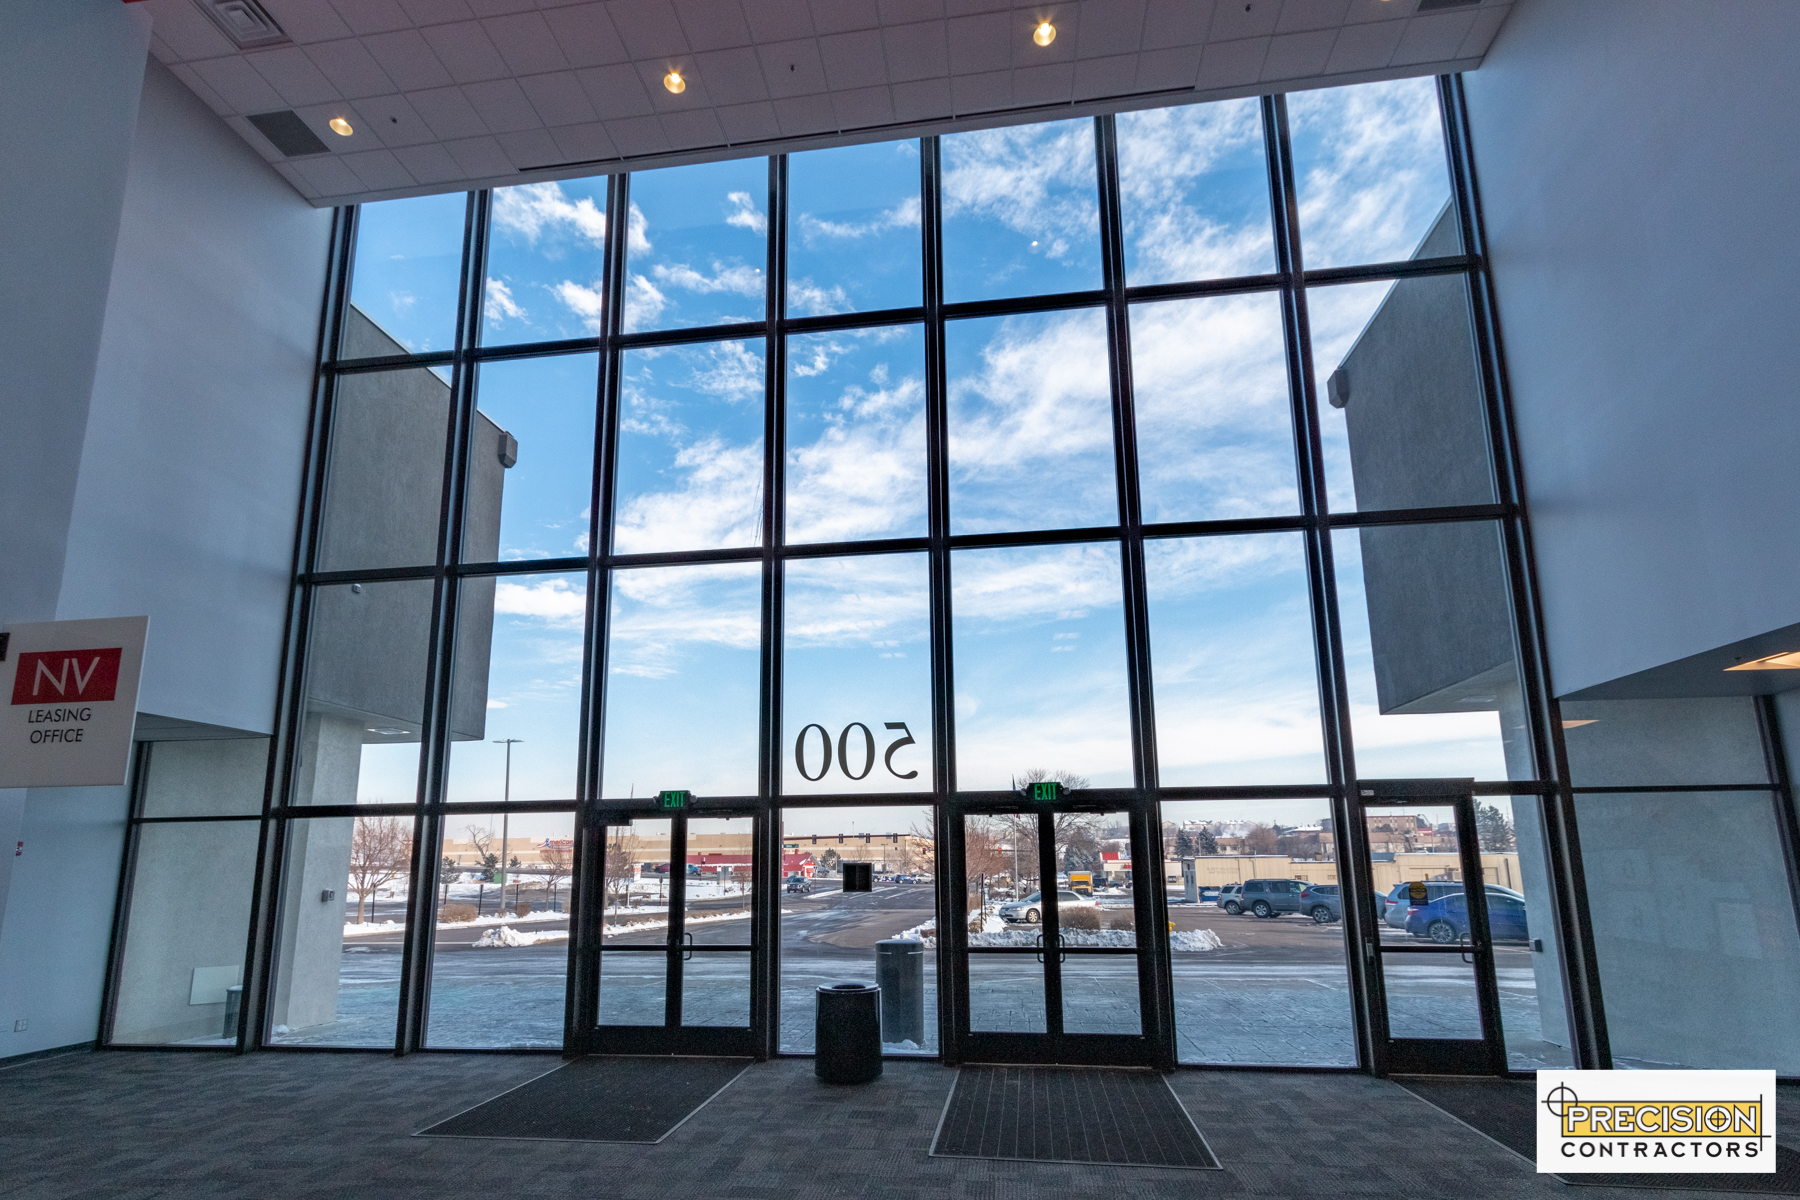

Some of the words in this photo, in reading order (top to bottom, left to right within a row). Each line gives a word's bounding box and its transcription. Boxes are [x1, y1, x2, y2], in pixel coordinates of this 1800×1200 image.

[32, 656, 100, 696] NV
[28, 707, 91, 723] LEASING
[30, 728, 84, 744] OFFICE
[664, 791, 685, 808] EXIT
[1034, 782, 1057, 800] EXIT
